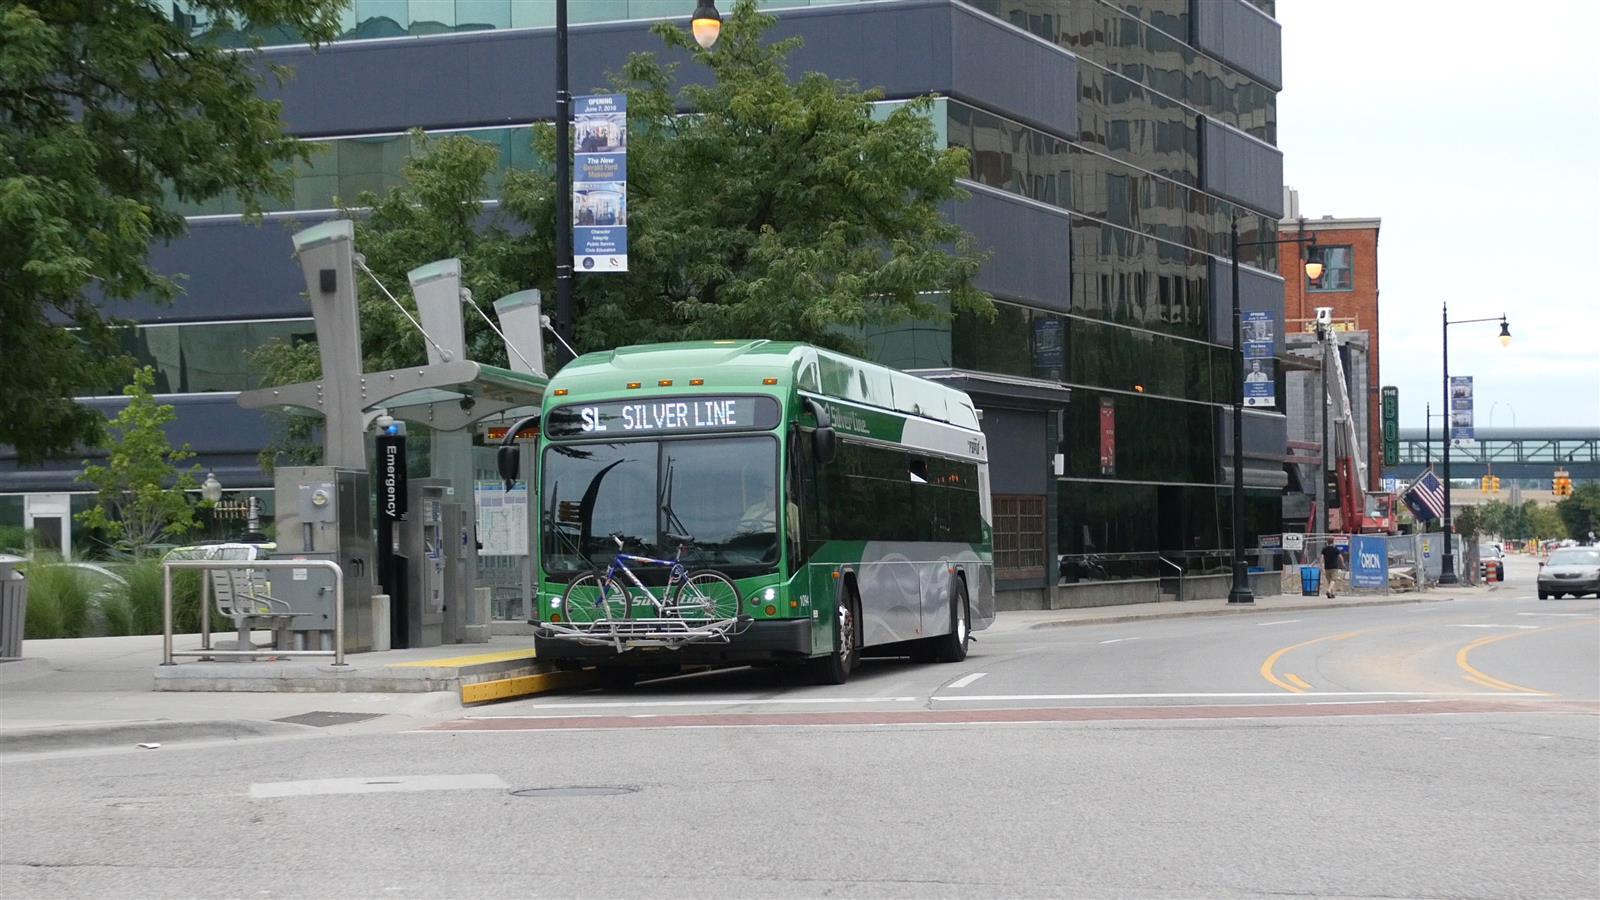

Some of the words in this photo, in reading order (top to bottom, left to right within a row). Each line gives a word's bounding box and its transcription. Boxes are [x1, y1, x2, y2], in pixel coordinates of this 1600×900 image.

[581, 407, 607, 432] SL
[622, 402, 688, 430] SILVER
[694, 400, 737, 426] LINE
[830, 405, 852, 430] Silver
[1385, 396, 1396, 466] BOB
[385, 445, 398, 517] Emergency
[1361, 553, 1380, 569] ORION
